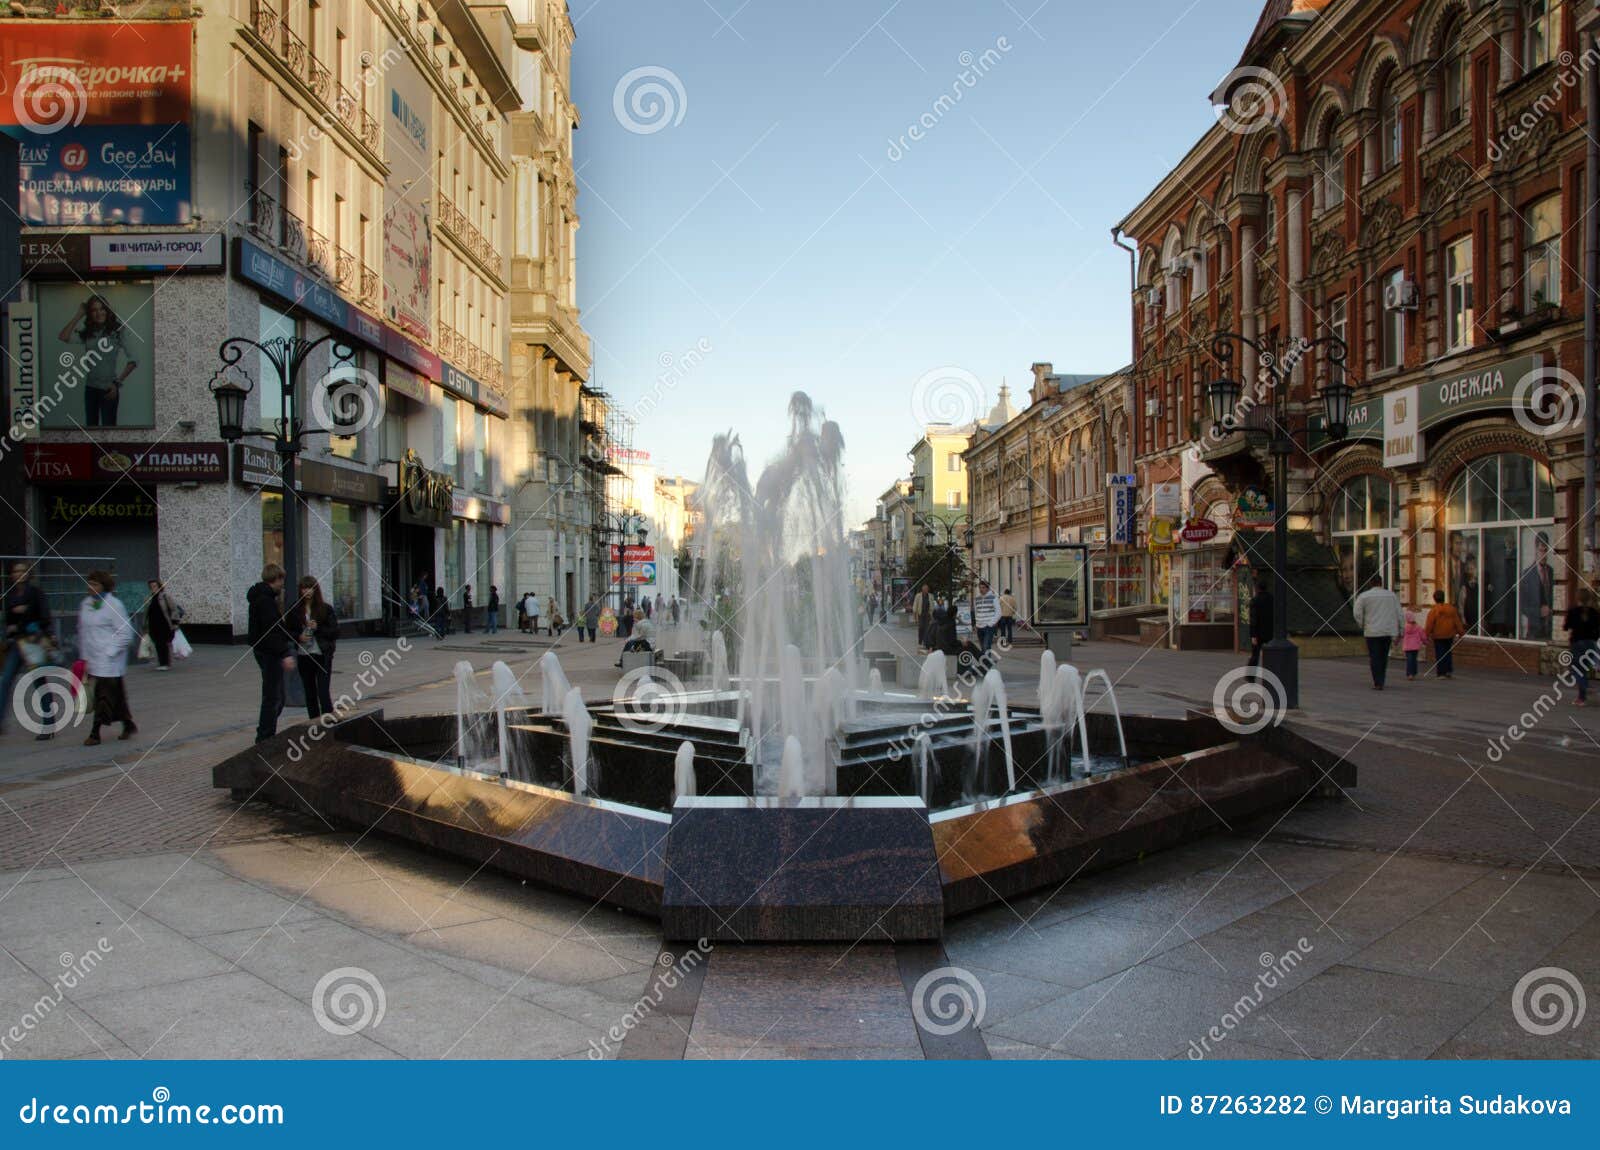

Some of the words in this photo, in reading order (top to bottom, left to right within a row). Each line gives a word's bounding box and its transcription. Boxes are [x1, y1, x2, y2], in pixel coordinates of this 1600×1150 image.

[101, 142, 137, 163] Gee
[142, 141, 176, 169] Jay
[29, 180, 82, 194] ОДЕЖДА
[84, 181, 94, 192] И
[96, 179, 176, 193] АКСЕССУАРЫ
[127, 241, 203, 253] ЧИТАЙ-ГОРОД
[13, 317, 33, 424] Balmond
[1439, 370, 1505, 404] ОДЕЖДА
[1320, 406, 1368, 430] МКАЯ
[133, 453, 144, 465] У
[149, 453, 220, 465] ПАЛЫЧА
[1111, 475, 1135, 485] AR
[48, 496, 157, 521] Accessoriz
[1116, 490, 1126, 541] PODIUM
